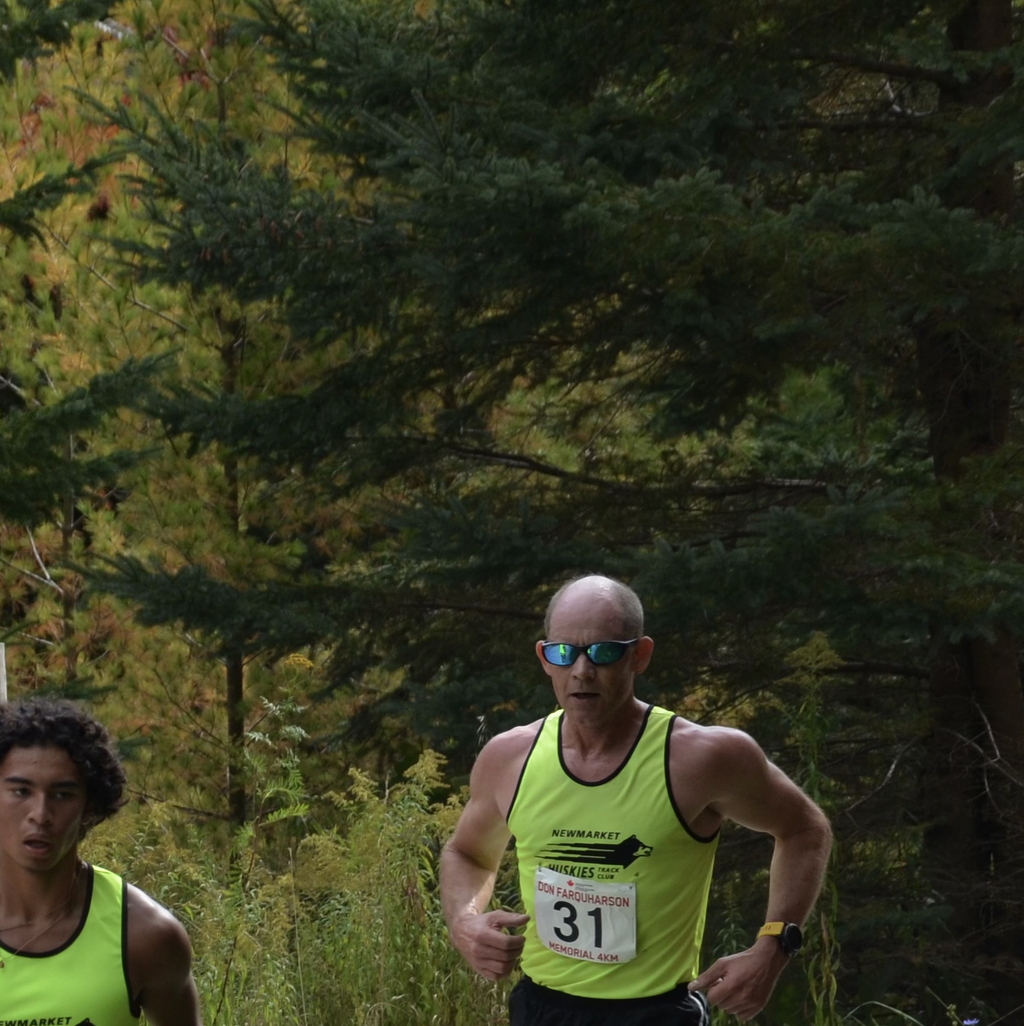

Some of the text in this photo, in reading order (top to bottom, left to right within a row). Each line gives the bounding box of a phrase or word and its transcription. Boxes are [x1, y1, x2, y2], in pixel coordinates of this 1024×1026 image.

[551, 829, 621, 840] NEWMARKET
[548, 864, 595, 879] HUSKIES
[538, 881, 555, 895] DON
[556, 887, 630, 907] FARQUHARSON
[553, 900, 603, 948] 31
[548, 941, 619, 962] MEMORIAL 4KM
